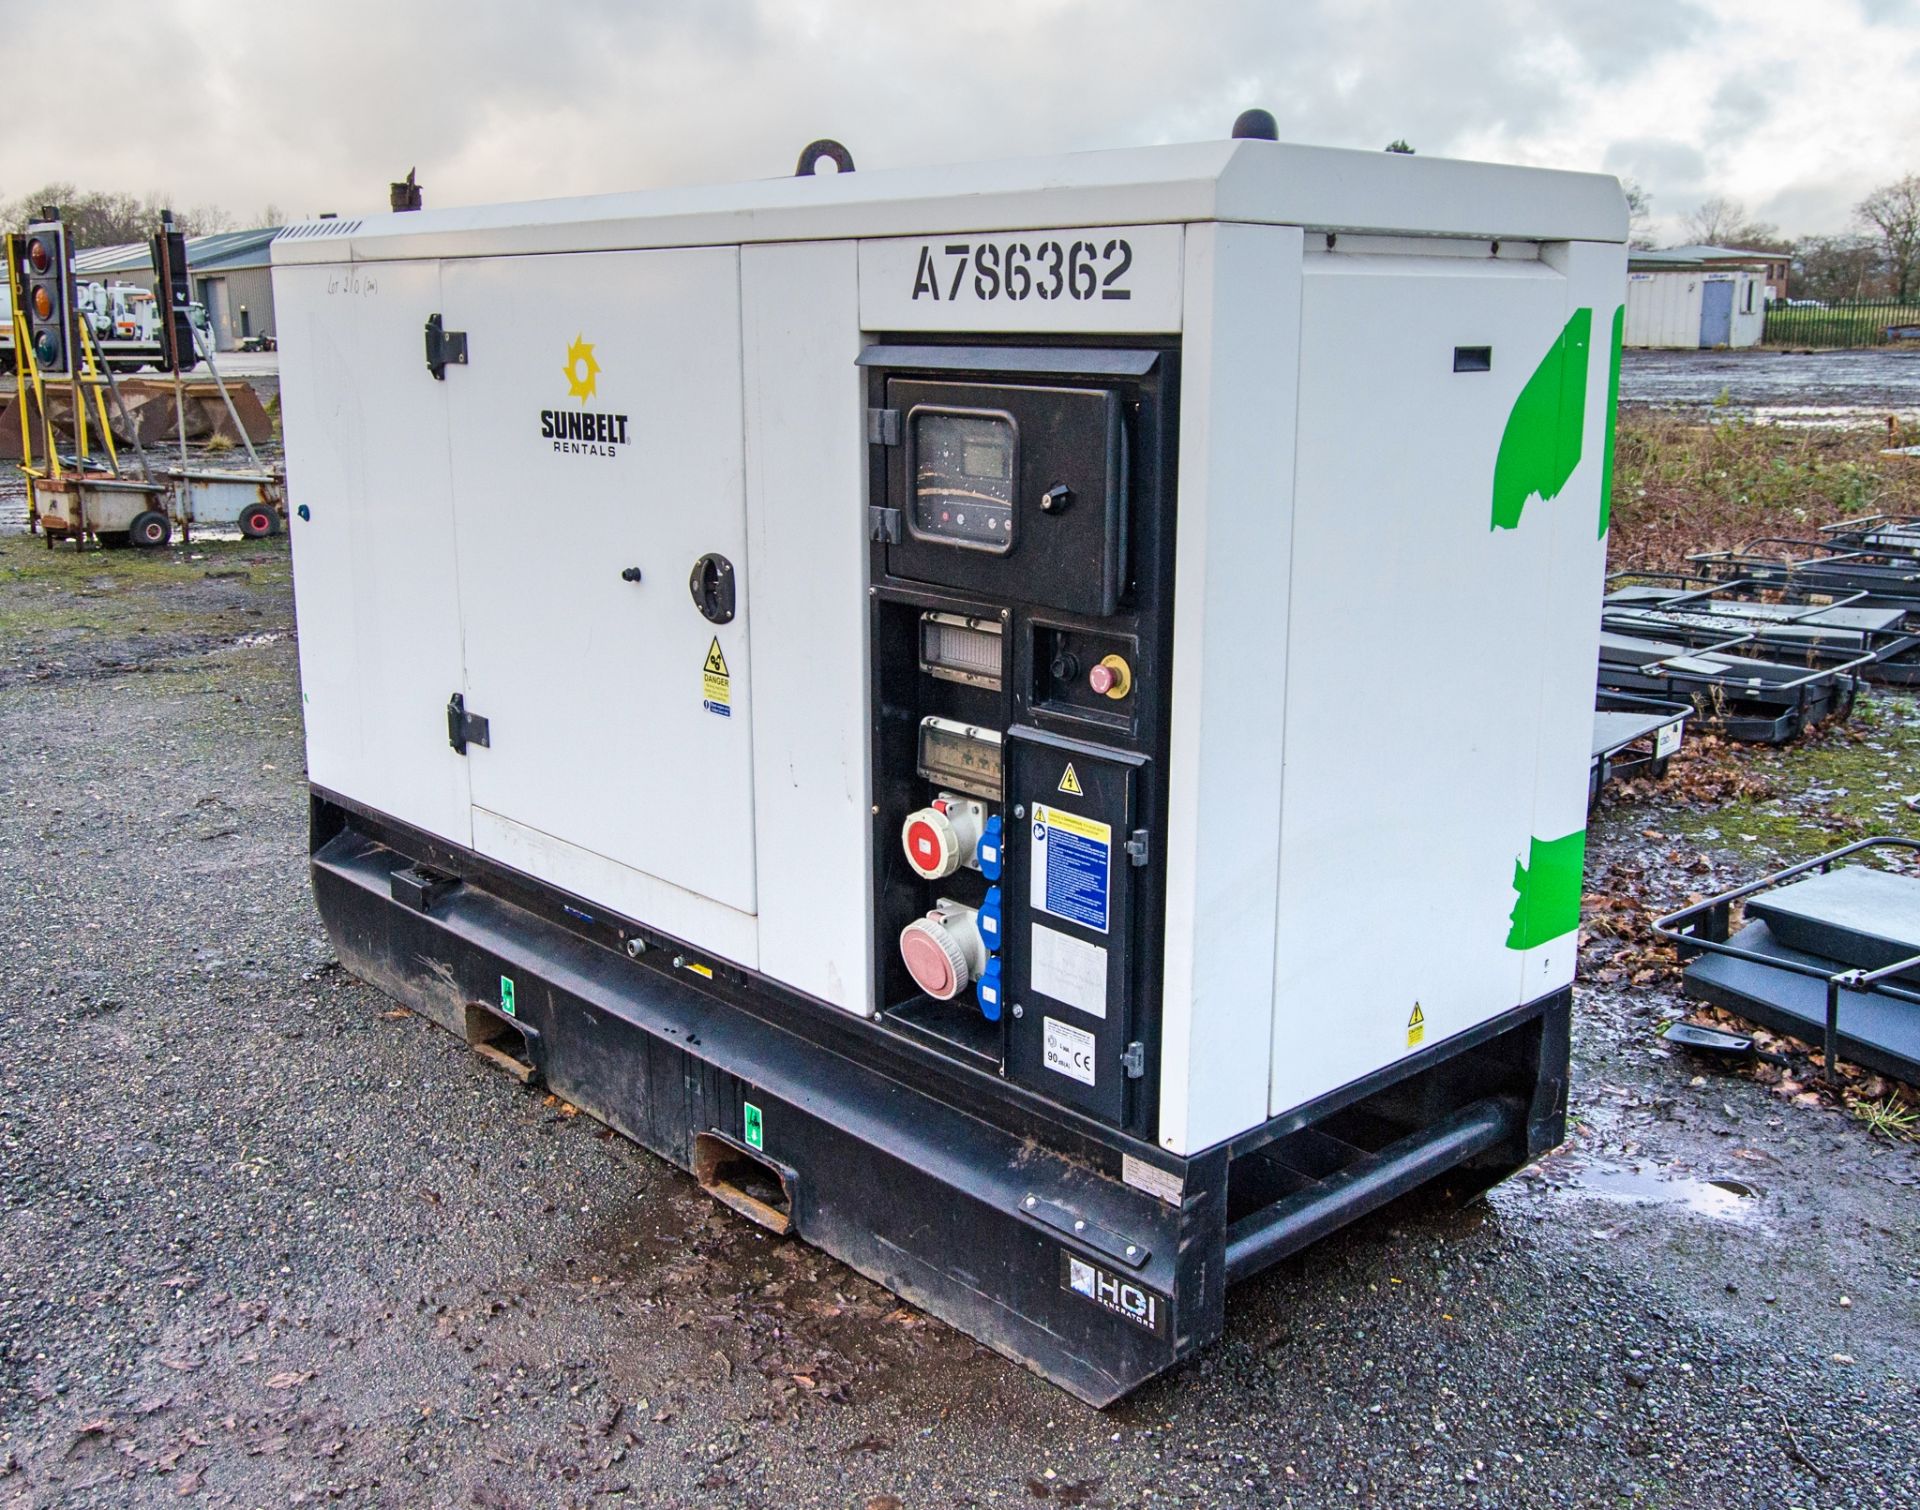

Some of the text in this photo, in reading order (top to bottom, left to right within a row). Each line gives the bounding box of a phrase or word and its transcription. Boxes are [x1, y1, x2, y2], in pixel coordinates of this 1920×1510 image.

[912, 239, 1132, 300] A7S6362
[541, 410, 628, 444] SUNBELT
[554, 441, 616, 457] RENTALS
[704, 674, 729, 687] DANGER
[1048, 1051, 1058, 1063] 90
[1097, 1296, 1155, 1330] GENERATORS
